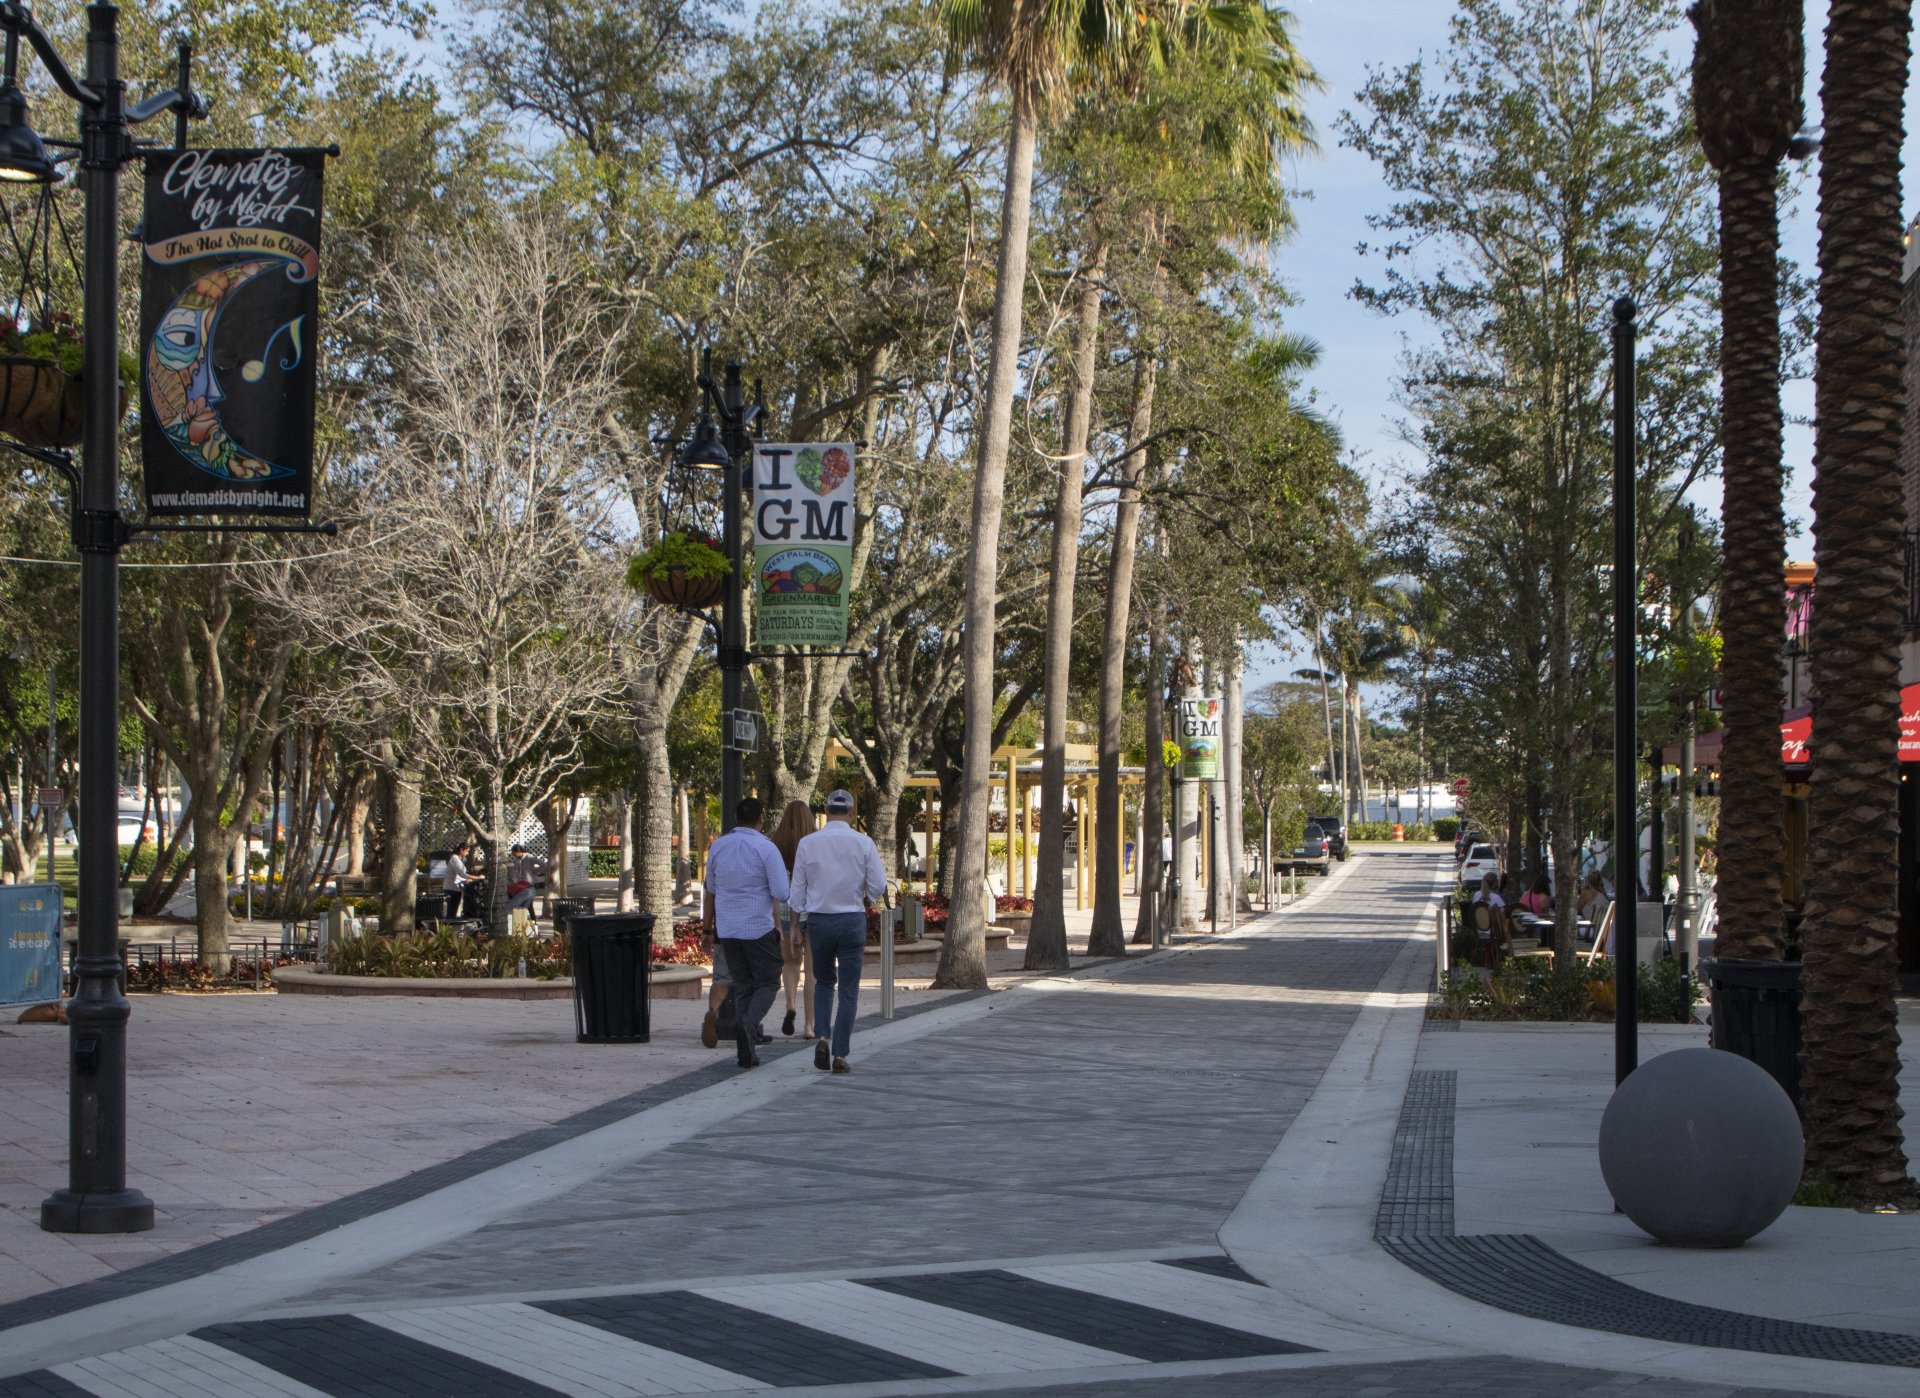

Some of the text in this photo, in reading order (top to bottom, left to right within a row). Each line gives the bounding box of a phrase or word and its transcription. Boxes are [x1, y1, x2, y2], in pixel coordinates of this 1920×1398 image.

[163, 149, 304, 198] Clematis
[192, 183, 315, 230] by Night
[165, 231, 312, 259] The Hot Spot to Chill
[759, 449, 792, 490] I
[152, 489, 305, 508] www.clematisbynight.net
[758, 499, 848, 541] GM
[765, 551, 839, 573] WEST PALM BEACH
[760, 616, 814, 630] SATURDAYS
[1183, 721, 1218, 737] GM
